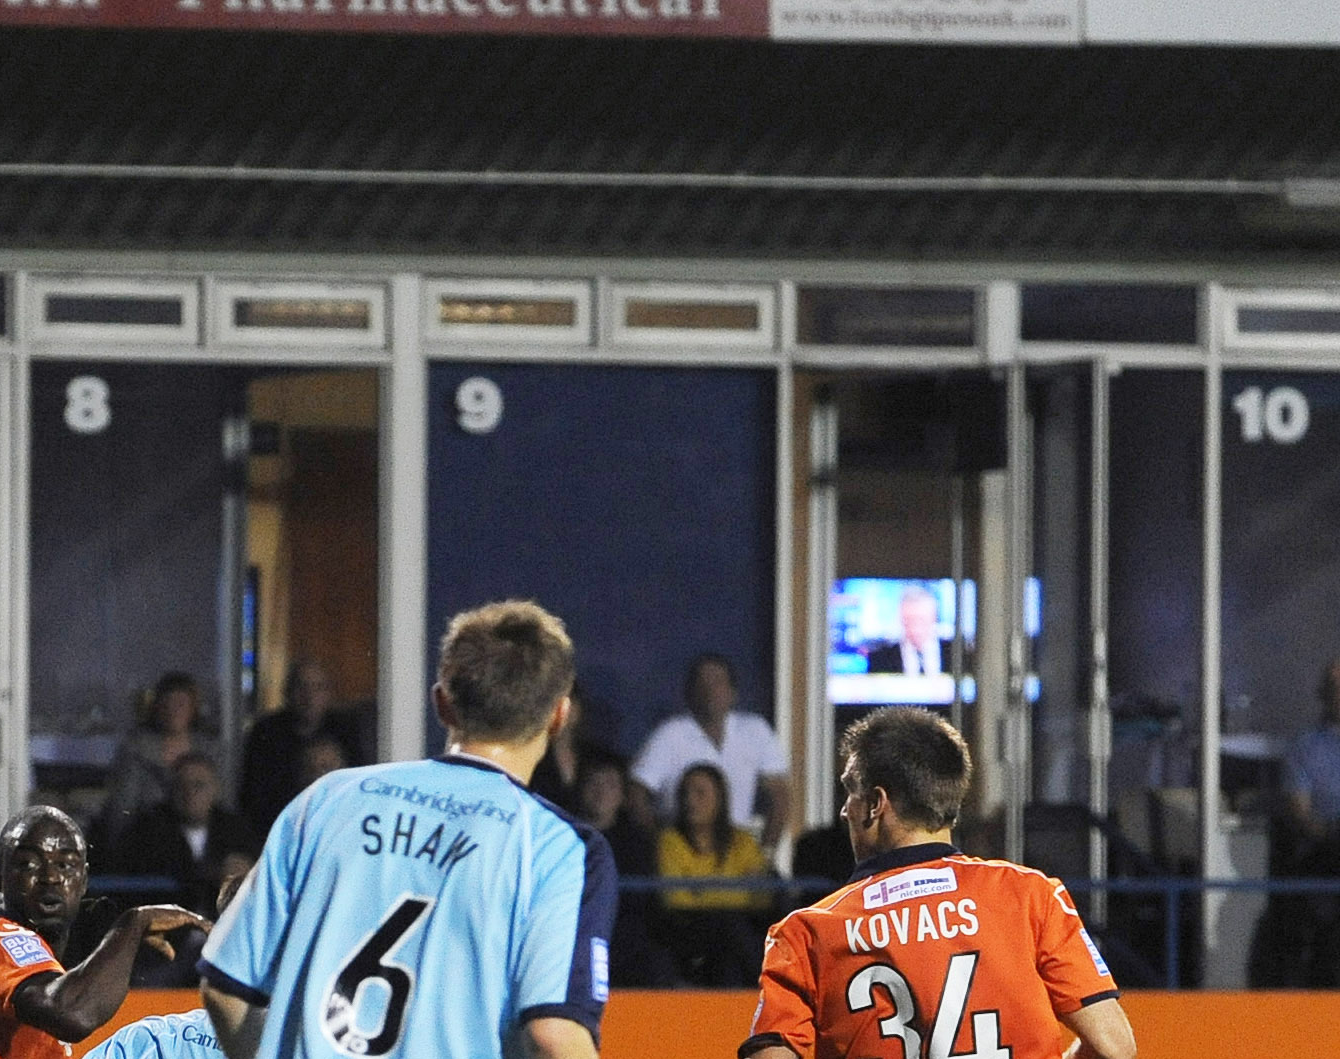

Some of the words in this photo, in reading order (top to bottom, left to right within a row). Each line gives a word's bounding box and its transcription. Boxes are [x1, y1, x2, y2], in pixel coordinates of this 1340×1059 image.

[64, 376, 110, 433] 8
[455, 376, 503, 433] 9
[1232, 386, 1309, 444] 10
[362, 812, 479, 876] SHAW
[844, 897, 980, 954] KOVACS
